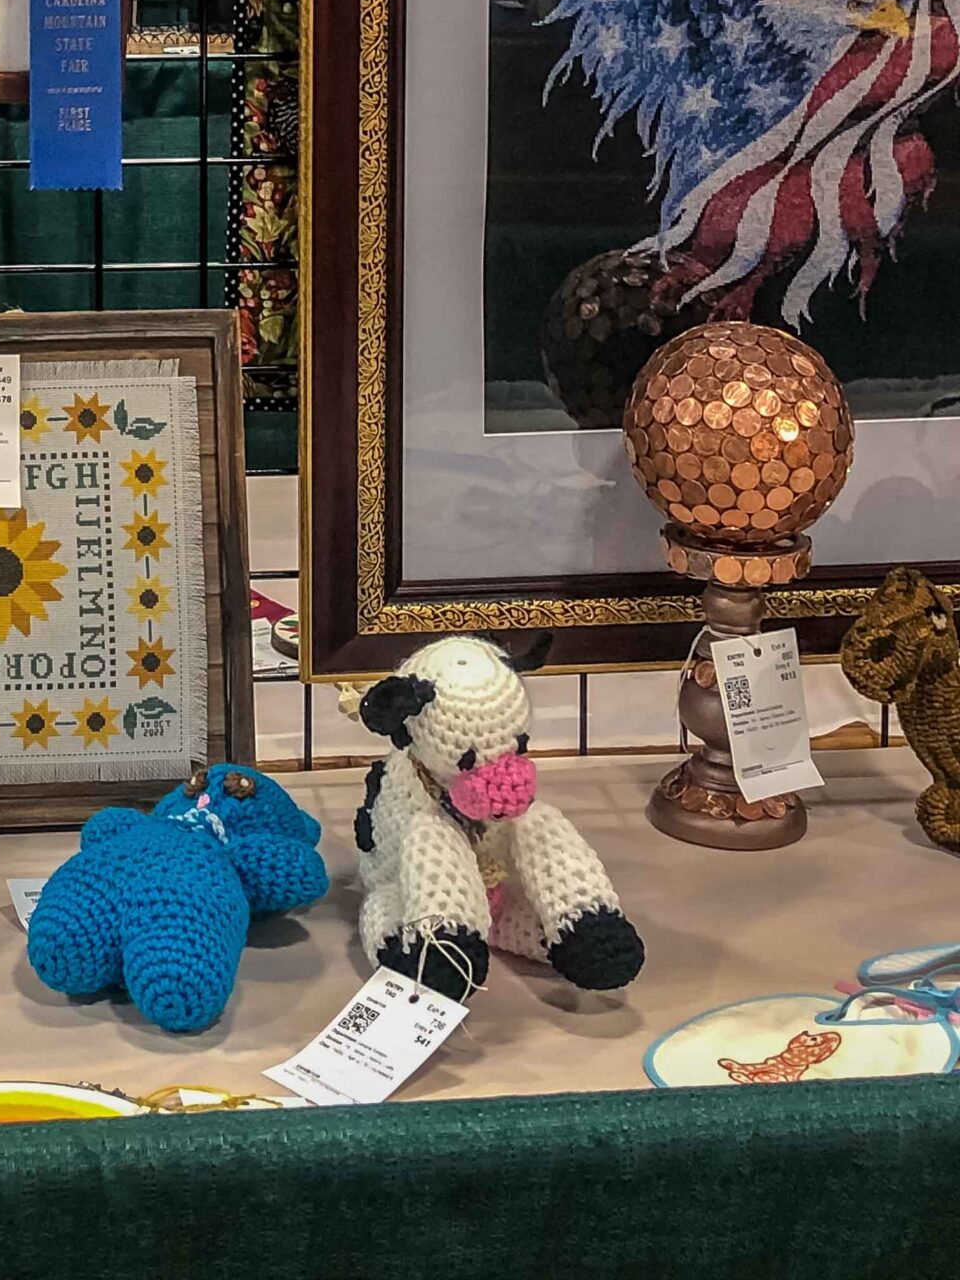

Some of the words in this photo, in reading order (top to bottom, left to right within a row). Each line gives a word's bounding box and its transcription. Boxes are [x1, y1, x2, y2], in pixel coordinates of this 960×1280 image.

[55, 38, 94, 51] STATE
[61, 60, 89, 73] FAIR
[59, 107, 90, 120] FIRST
[58, 120, 91, 131] PLACE
[414, 1035, 431, 1048] 541
